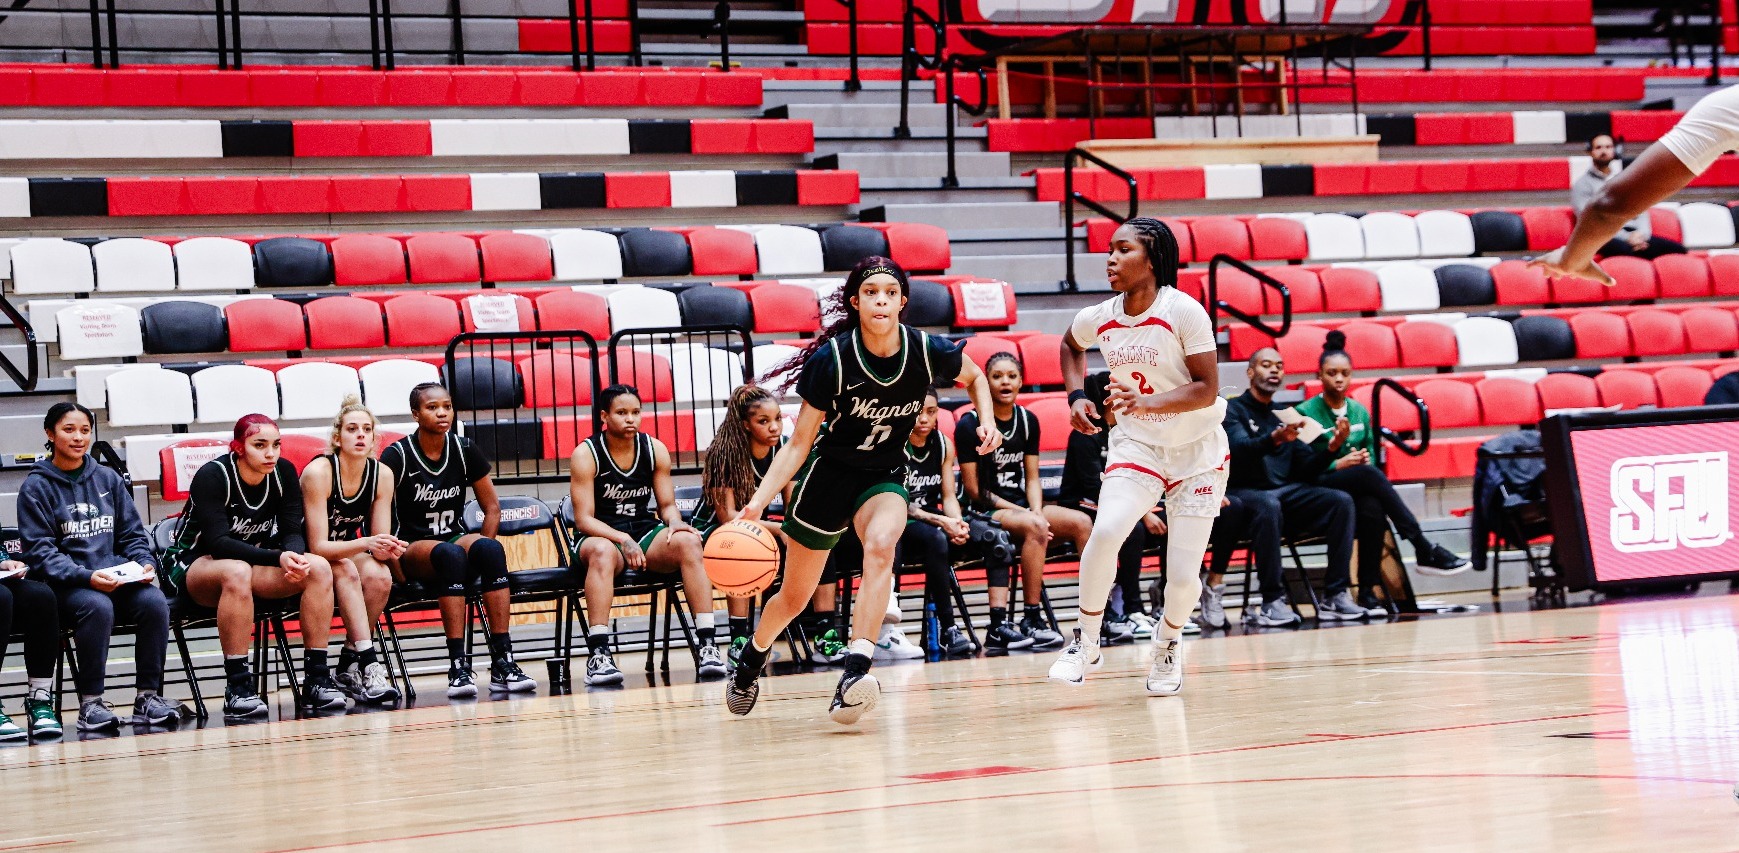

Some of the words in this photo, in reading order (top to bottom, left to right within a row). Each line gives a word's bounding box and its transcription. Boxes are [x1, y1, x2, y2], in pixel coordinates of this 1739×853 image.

[1108, 346, 1158, 369] SAINT
[1131, 371, 1154, 394] 2
[850, 397, 922, 425] Wagner
[414, 483, 460, 508] Wagner
[603, 483, 650, 506] Wagner
[1194, 486, 1213, 494] NEC
[1610, 451, 1729, 553] SFU
[61, 515, 114, 535] WAGNER
[425, 509, 455, 535] 30
